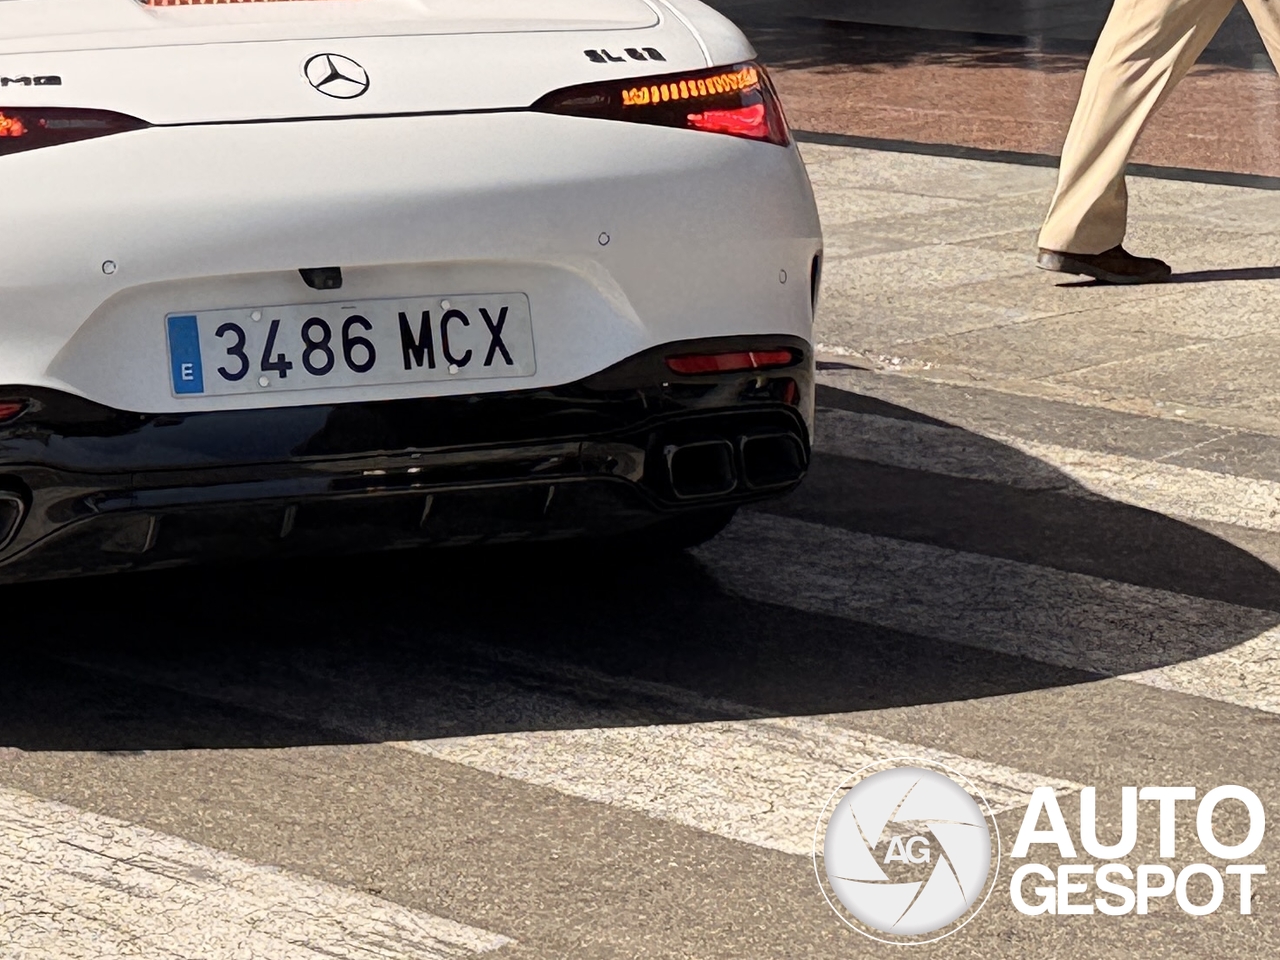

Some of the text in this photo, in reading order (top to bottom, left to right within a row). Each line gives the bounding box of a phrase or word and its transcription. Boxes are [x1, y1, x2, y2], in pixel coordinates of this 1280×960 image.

[214, 306, 515, 382] 3486 MCX
[181, 363, 194, 381] E
